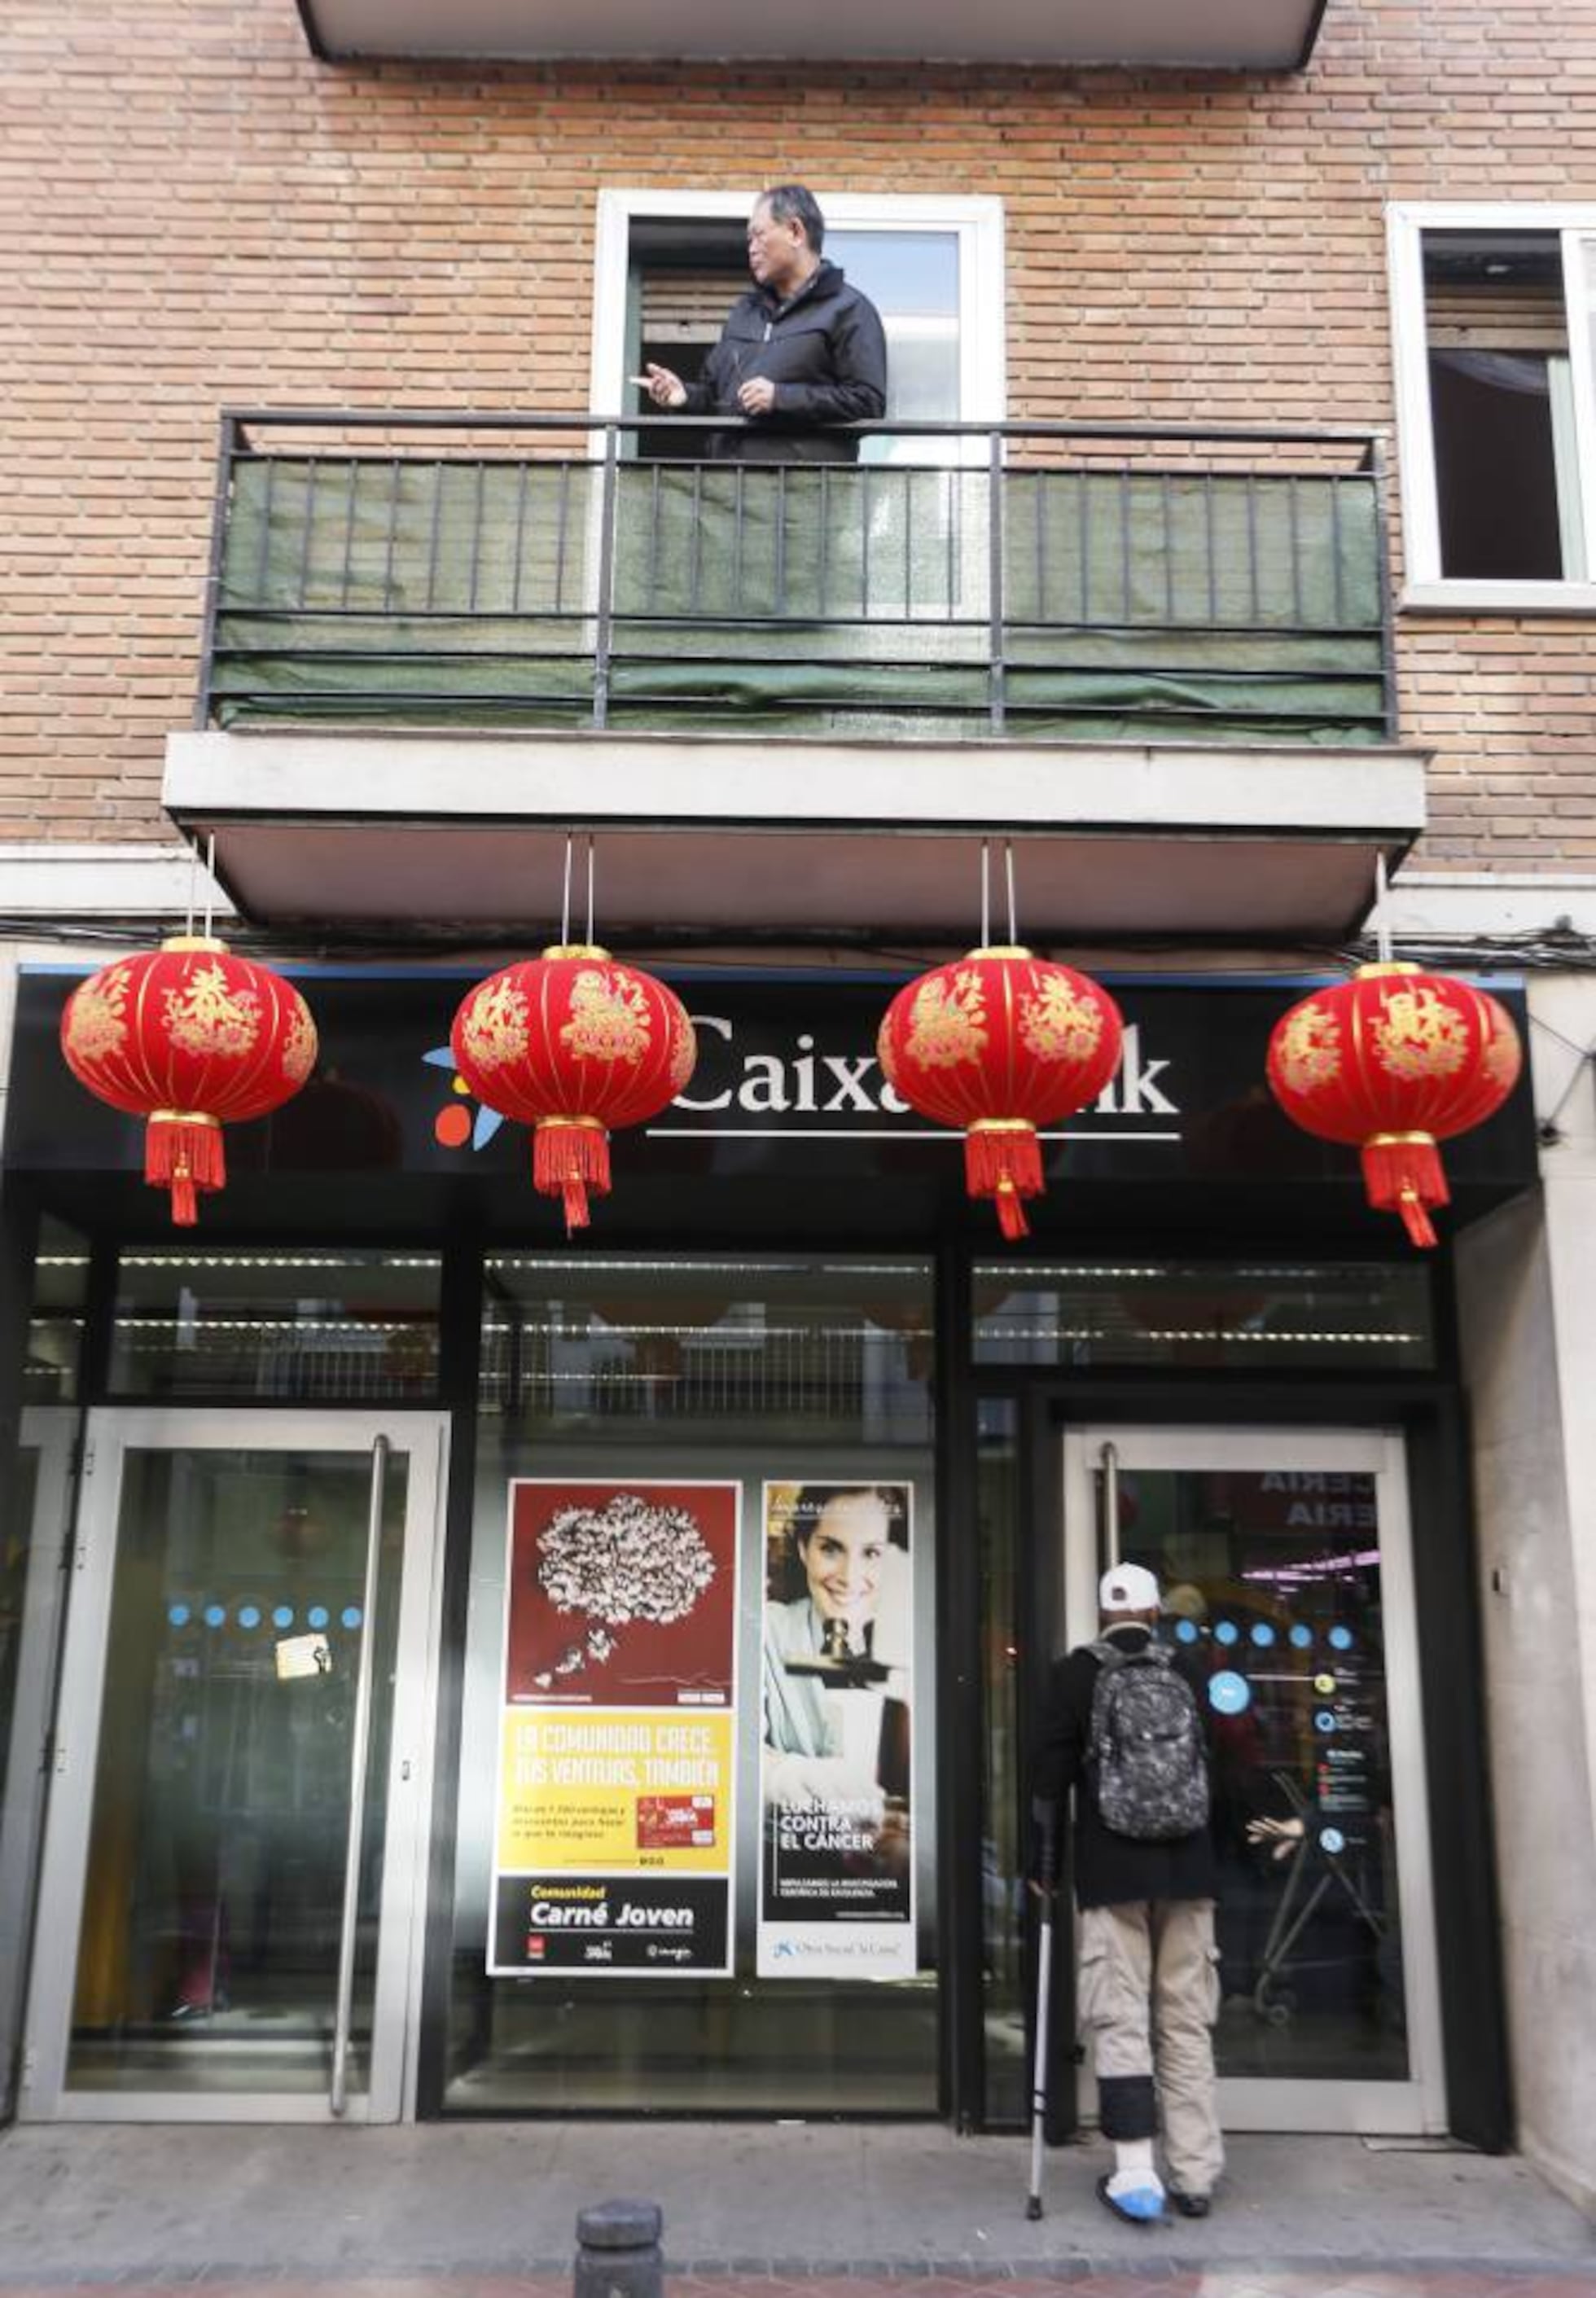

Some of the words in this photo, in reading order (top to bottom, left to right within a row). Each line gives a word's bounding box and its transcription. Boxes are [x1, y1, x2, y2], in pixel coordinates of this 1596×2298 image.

[542, 1724, 651, 1752] COMUNIDAD
[780, 1815, 852, 1832] CONTRA
[779, 1833, 801, 1850] EL
[530, 1885, 607, 1900] Comunidad
[530, 1902, 608, 1927] Carné
[615, 1904, 694, 1927] Joven
